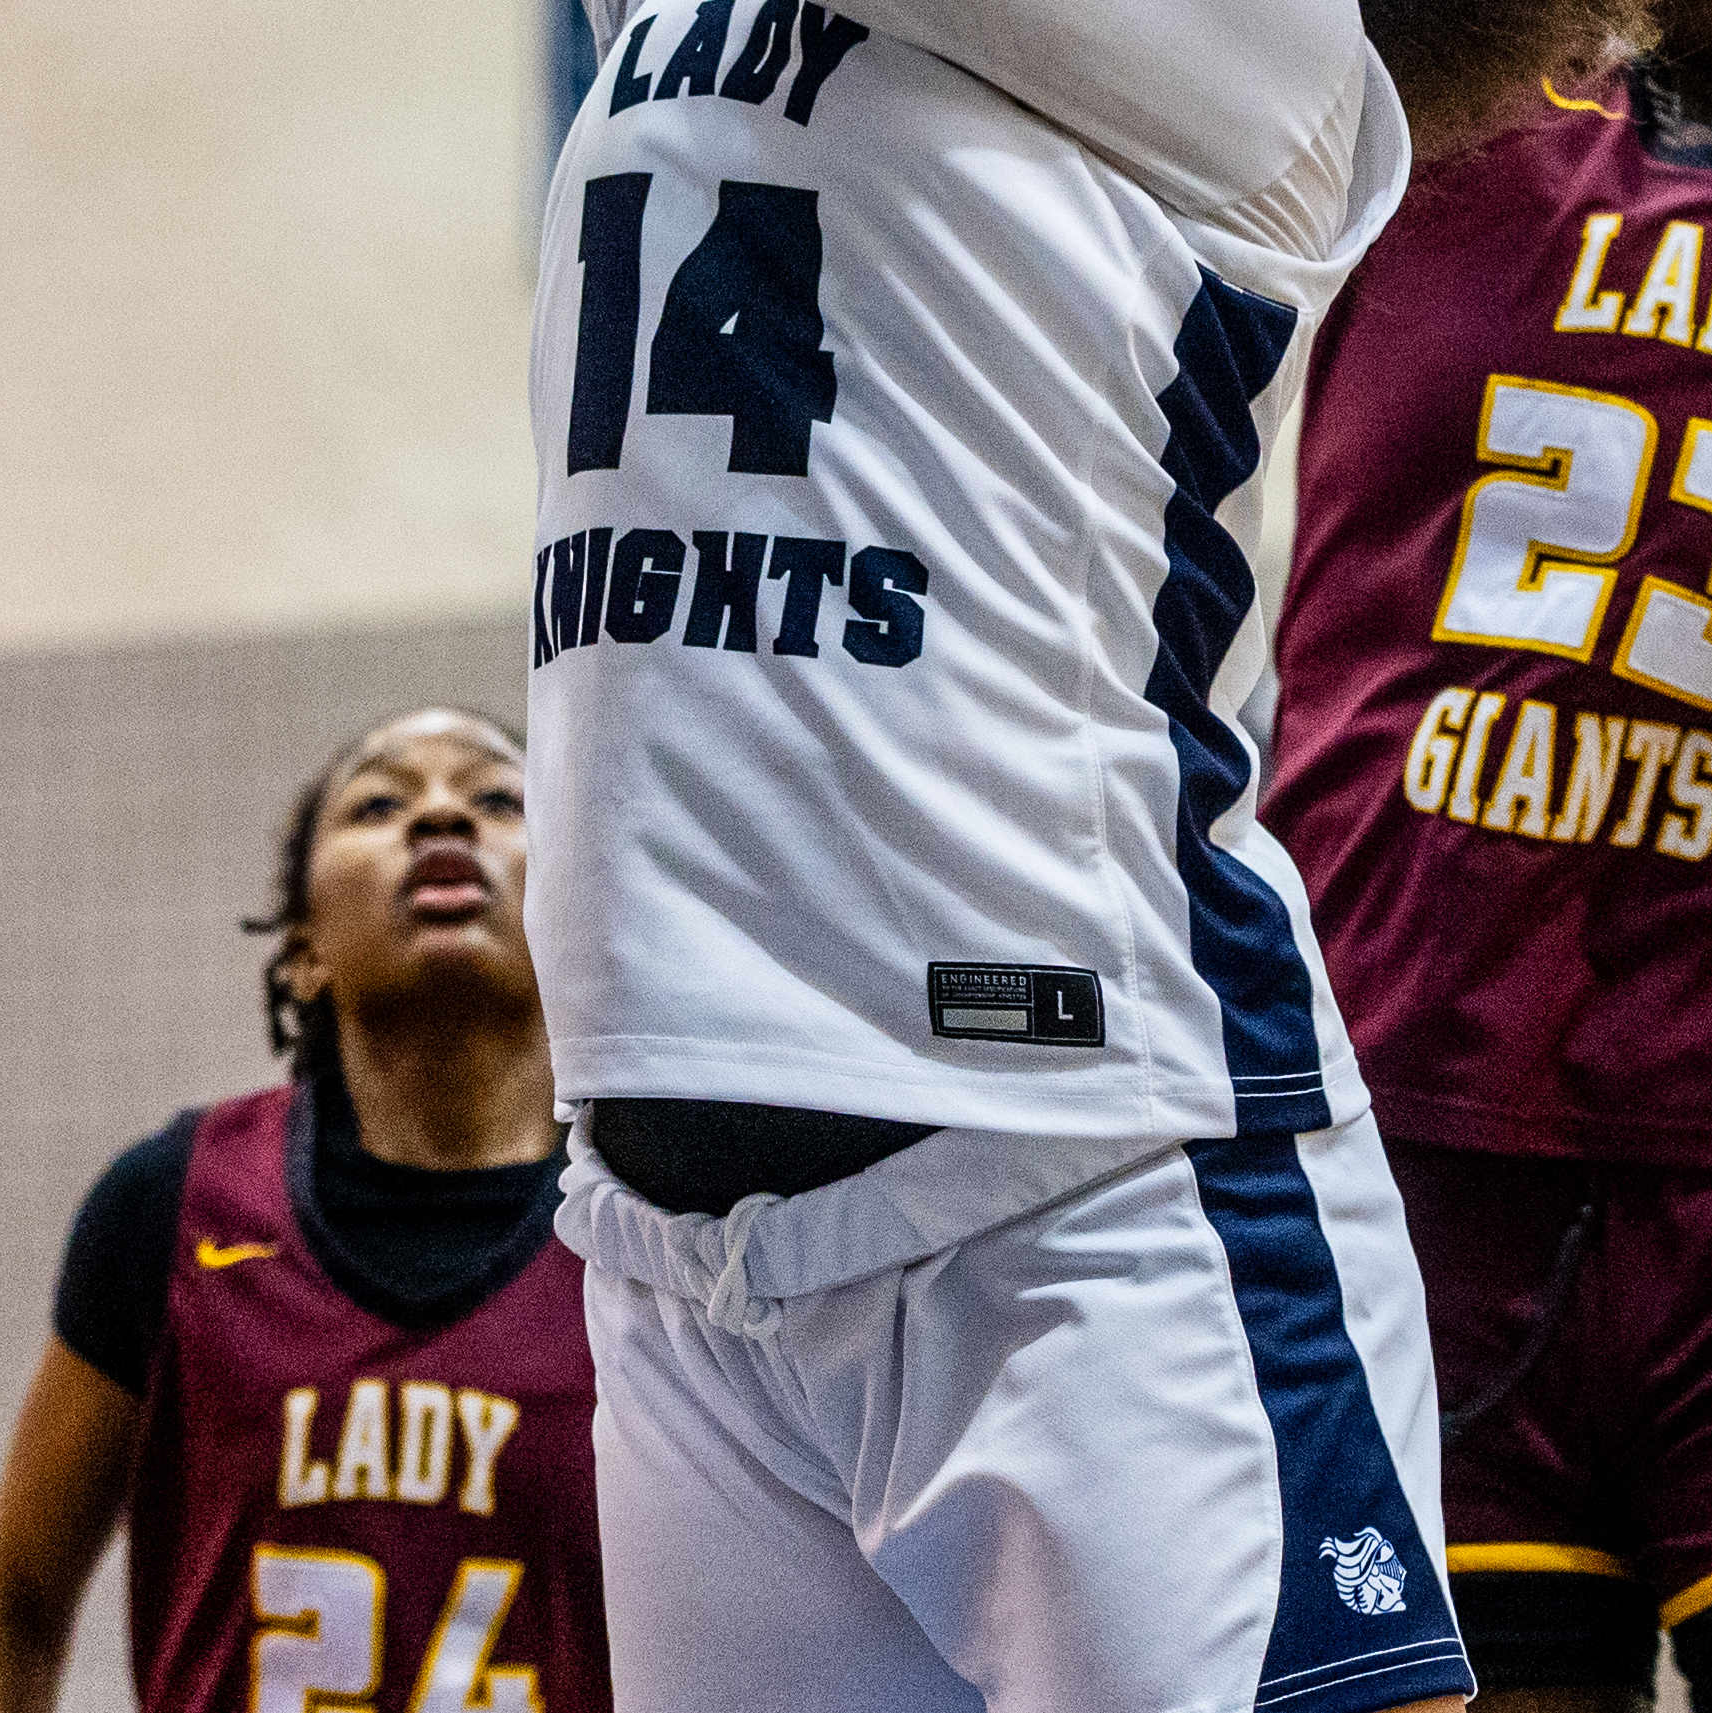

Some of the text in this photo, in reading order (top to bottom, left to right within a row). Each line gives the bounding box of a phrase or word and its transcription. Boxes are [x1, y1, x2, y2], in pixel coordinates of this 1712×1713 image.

[567, 172, 838, 478] 14
[533, 526, 930, 670] KNIGHTS
[940, 973, 1027, 987] ENGINEERED
[1056, 989, 1075, 1022] L
[278, 1377, 521, 1517] LADY
[249, 1540, 547, 1713] 24
